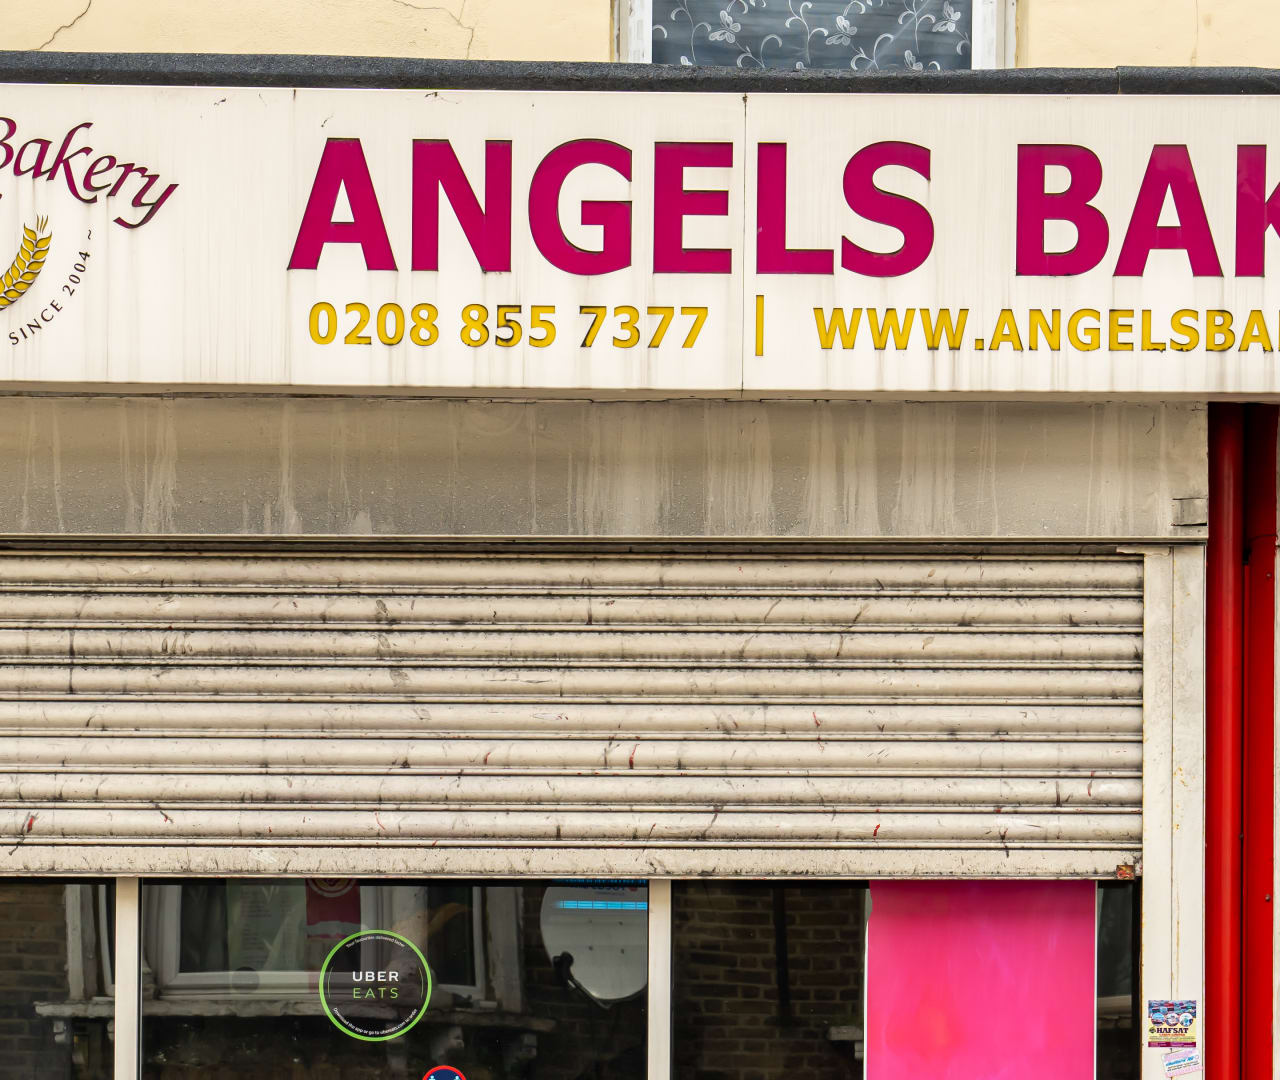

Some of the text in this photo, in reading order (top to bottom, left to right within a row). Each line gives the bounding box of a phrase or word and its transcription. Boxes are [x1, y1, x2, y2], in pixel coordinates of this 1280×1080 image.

[287, 138, 935, 277] ANGELS
[8, 299, 63, 346] SINCE
[62, 250, 91, 296] 2004
[308, 301, 439, 346] 0208
[460, 303, 557, 347] 855
[579, 305, 709, 348] 7377
[352, 971, 399, 981] UBER
[353, 988, 399, 999] EATS
